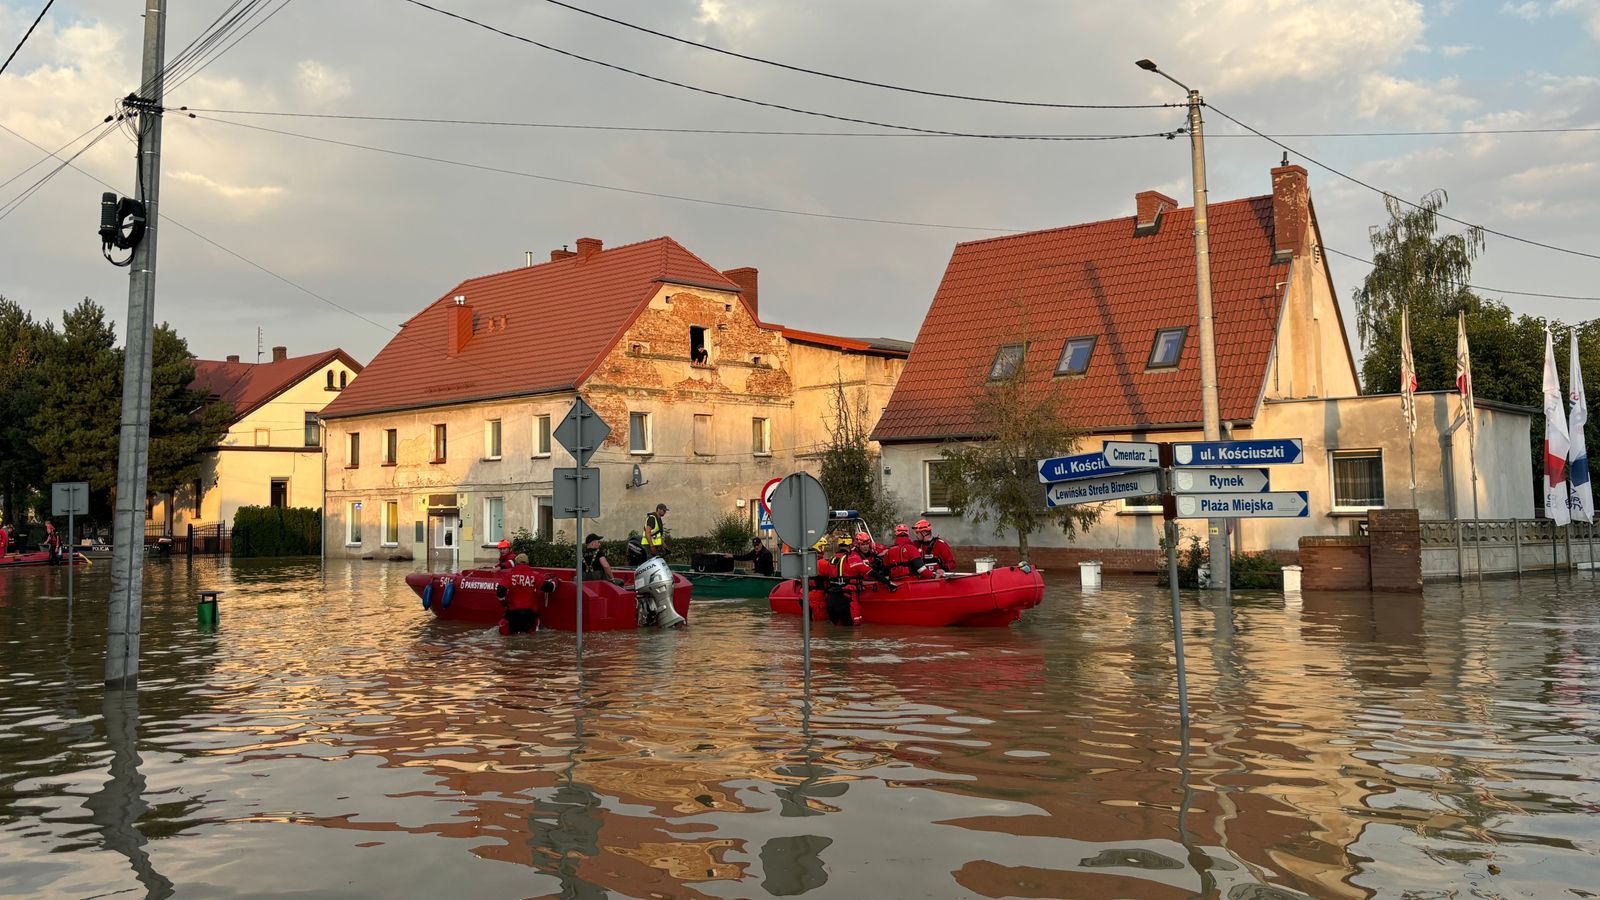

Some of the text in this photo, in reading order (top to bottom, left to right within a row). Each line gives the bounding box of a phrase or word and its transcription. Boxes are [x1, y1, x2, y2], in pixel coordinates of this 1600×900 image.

[1113, 448, 1146, 461] Cmentarz
[1200, 446, 1285, 460] ul. Kościuszki
[1054, 463, 1068, 475] ul.
[1209, 474, 1244, 489] Rynek
[1055, 481, 1138, 500] Lewińska Strefa Biznesu
[1201, 499, 1274, 514] Plaża Miejska
